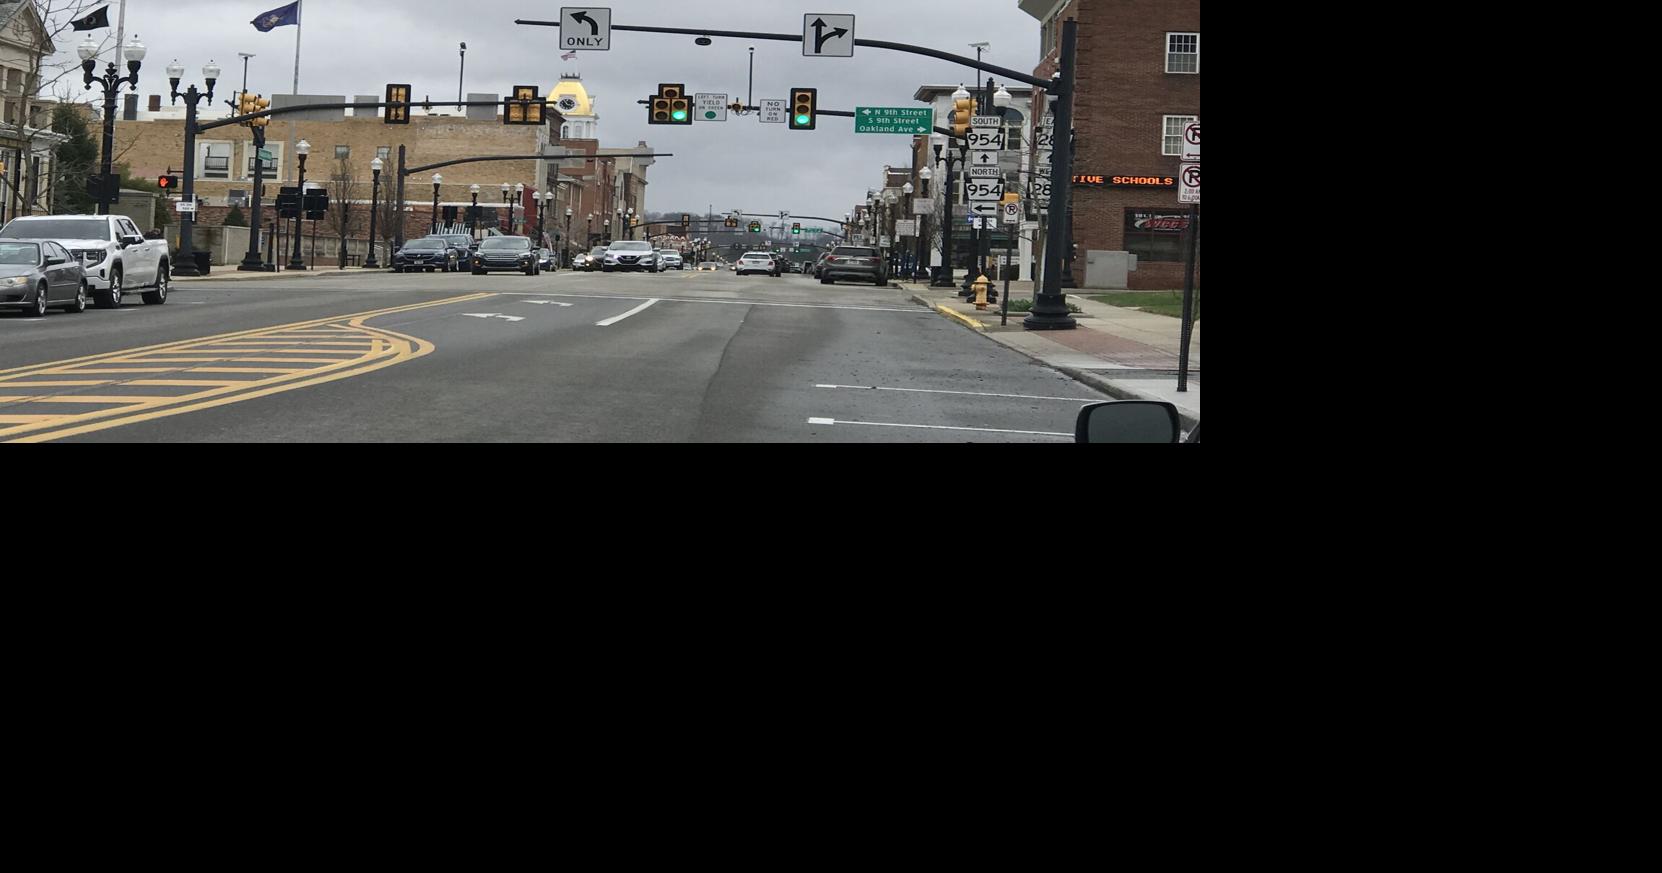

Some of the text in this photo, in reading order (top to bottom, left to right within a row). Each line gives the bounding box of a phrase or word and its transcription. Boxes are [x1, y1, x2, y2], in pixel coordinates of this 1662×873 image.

[567, 37, 603, 46] ONLY
[967, 133, 1002, 146] 954
[971, 168, 999, 176] NORTH
[1113, 176, 1173, 185] SCHOOLS
[967, 184, 1001, 196] 954
